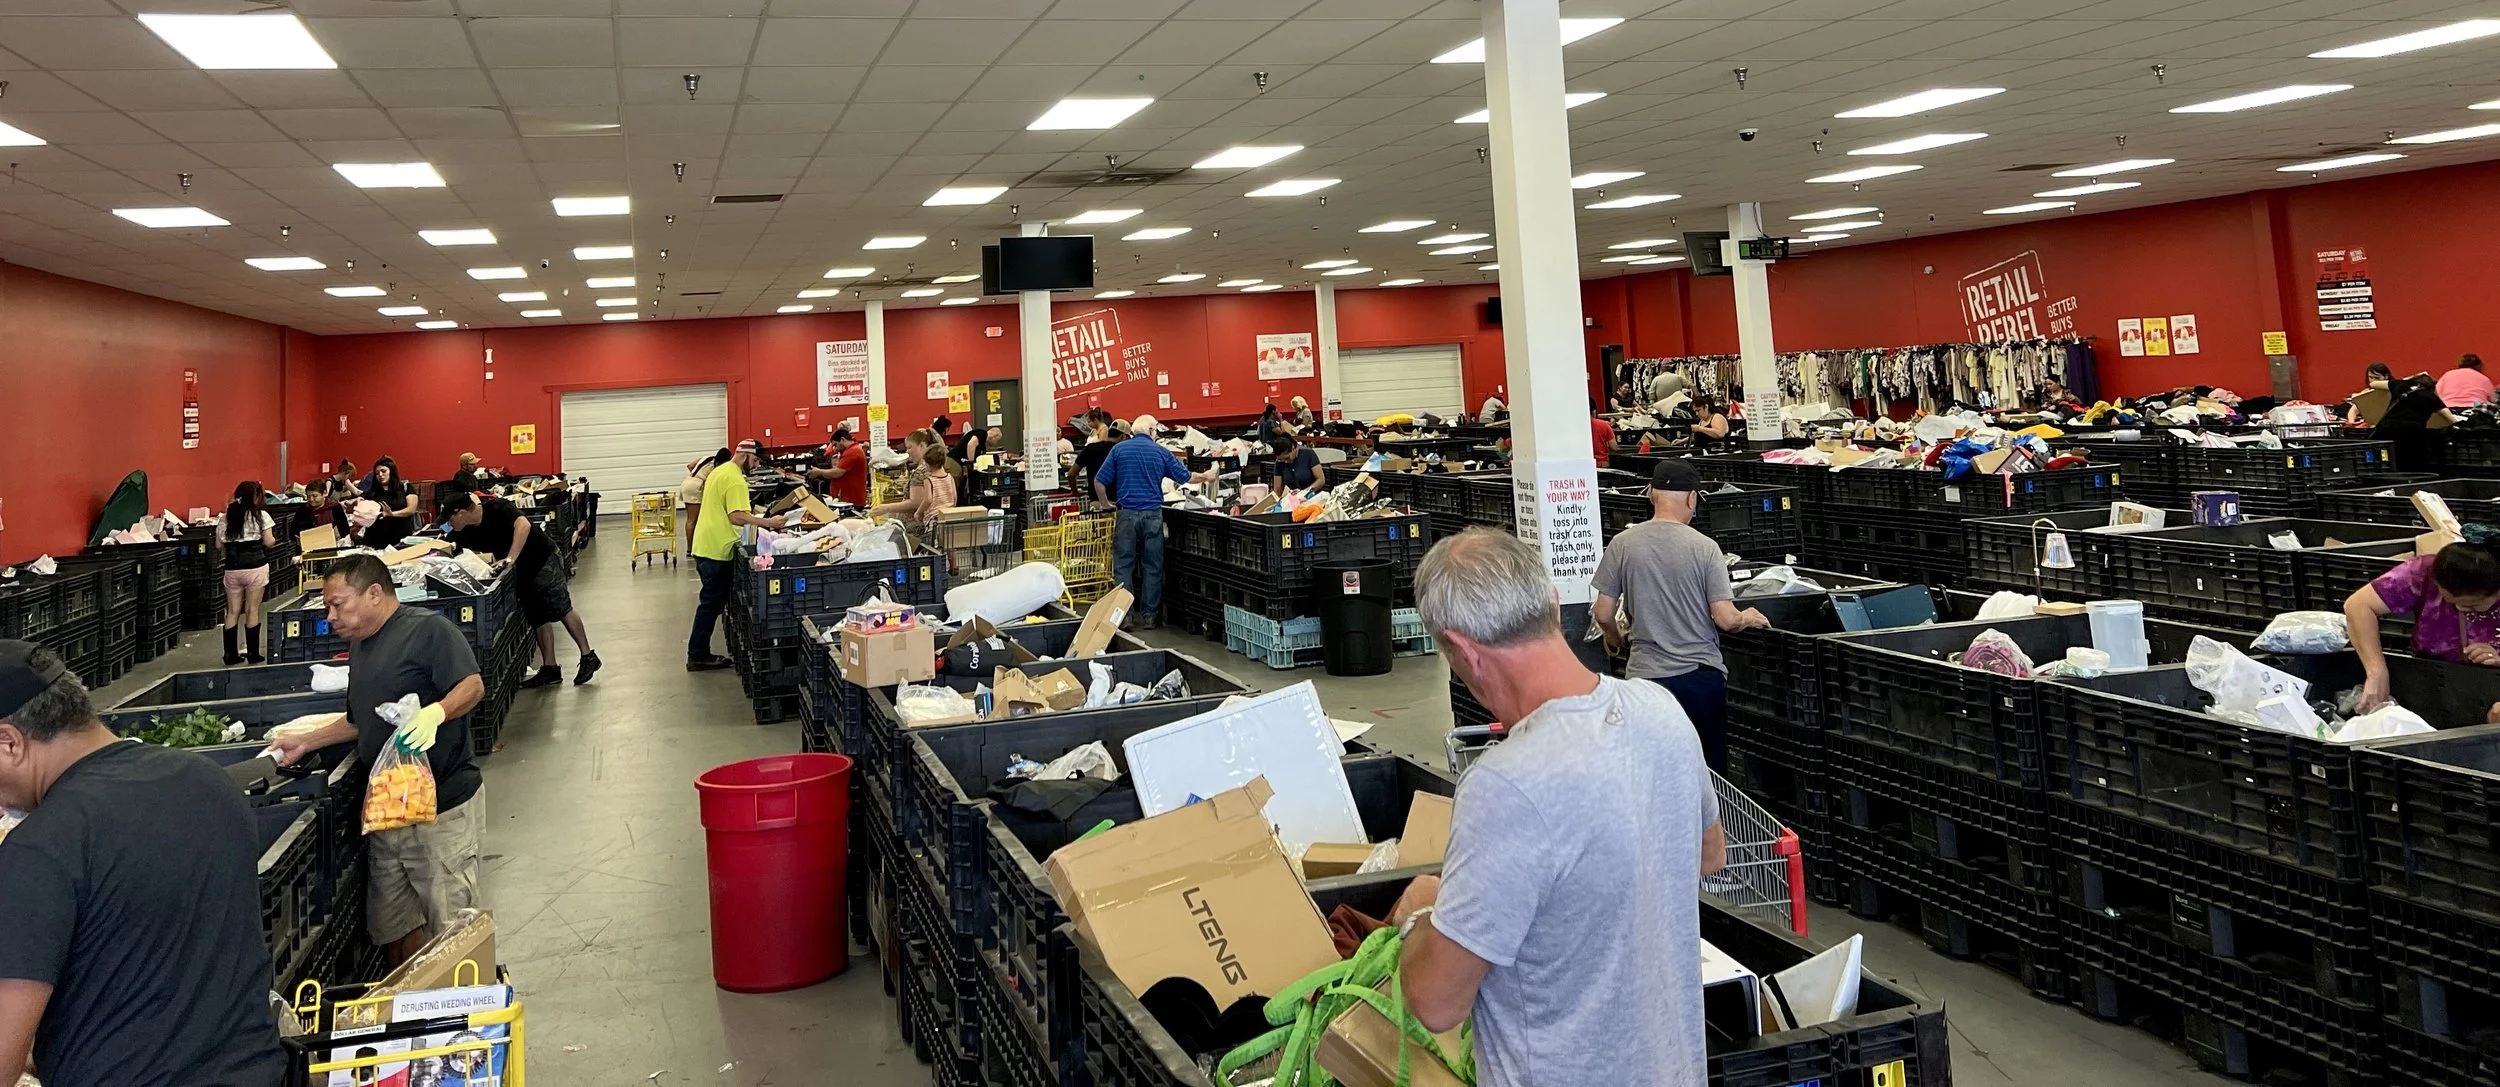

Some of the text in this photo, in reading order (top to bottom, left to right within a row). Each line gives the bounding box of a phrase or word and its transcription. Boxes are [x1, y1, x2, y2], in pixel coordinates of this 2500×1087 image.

[1966, 266, 2039, 322] RETAIL
[2047, 296, 2078, 318] BETTER
[2050, 315, 2073, 334] BUYS
[1051, 319, 1115, 360] ETAIL
[825, 342, 867, 355] SATURDAY
[1122, 342, 1152, 359] BETTER
[1052, 350, 1120, 391] REBEL
[1125, 356, 1146, 371] BUYS
[1127, 367, 1150, 382] DAILY
[1516, 479, 1528, 490] Please
[1549, 478, 1586, 490] TRASH IN
[1546, 489, 1590, 503] YOUR WAY?
[1556, 504, 1582, 516] Kindly
[1553, 516, 1588, 528] toss into
[1549, 529, 1570, 540] trash
[1551, 542, 1574, 553] Trash
[1551, 552, 1596, 567] please and
[1553, 566, 1577, 577] thank
[1182, 886, 1248, 986] LTENG
[401, 1002, 439, 1014] DERUSTING
[440, 998, 472, 1010] WEEDING
[473, 995, 496, 1006] WHEEL
[334, 1026, 383, 1038] DOLLAR GENERAL
